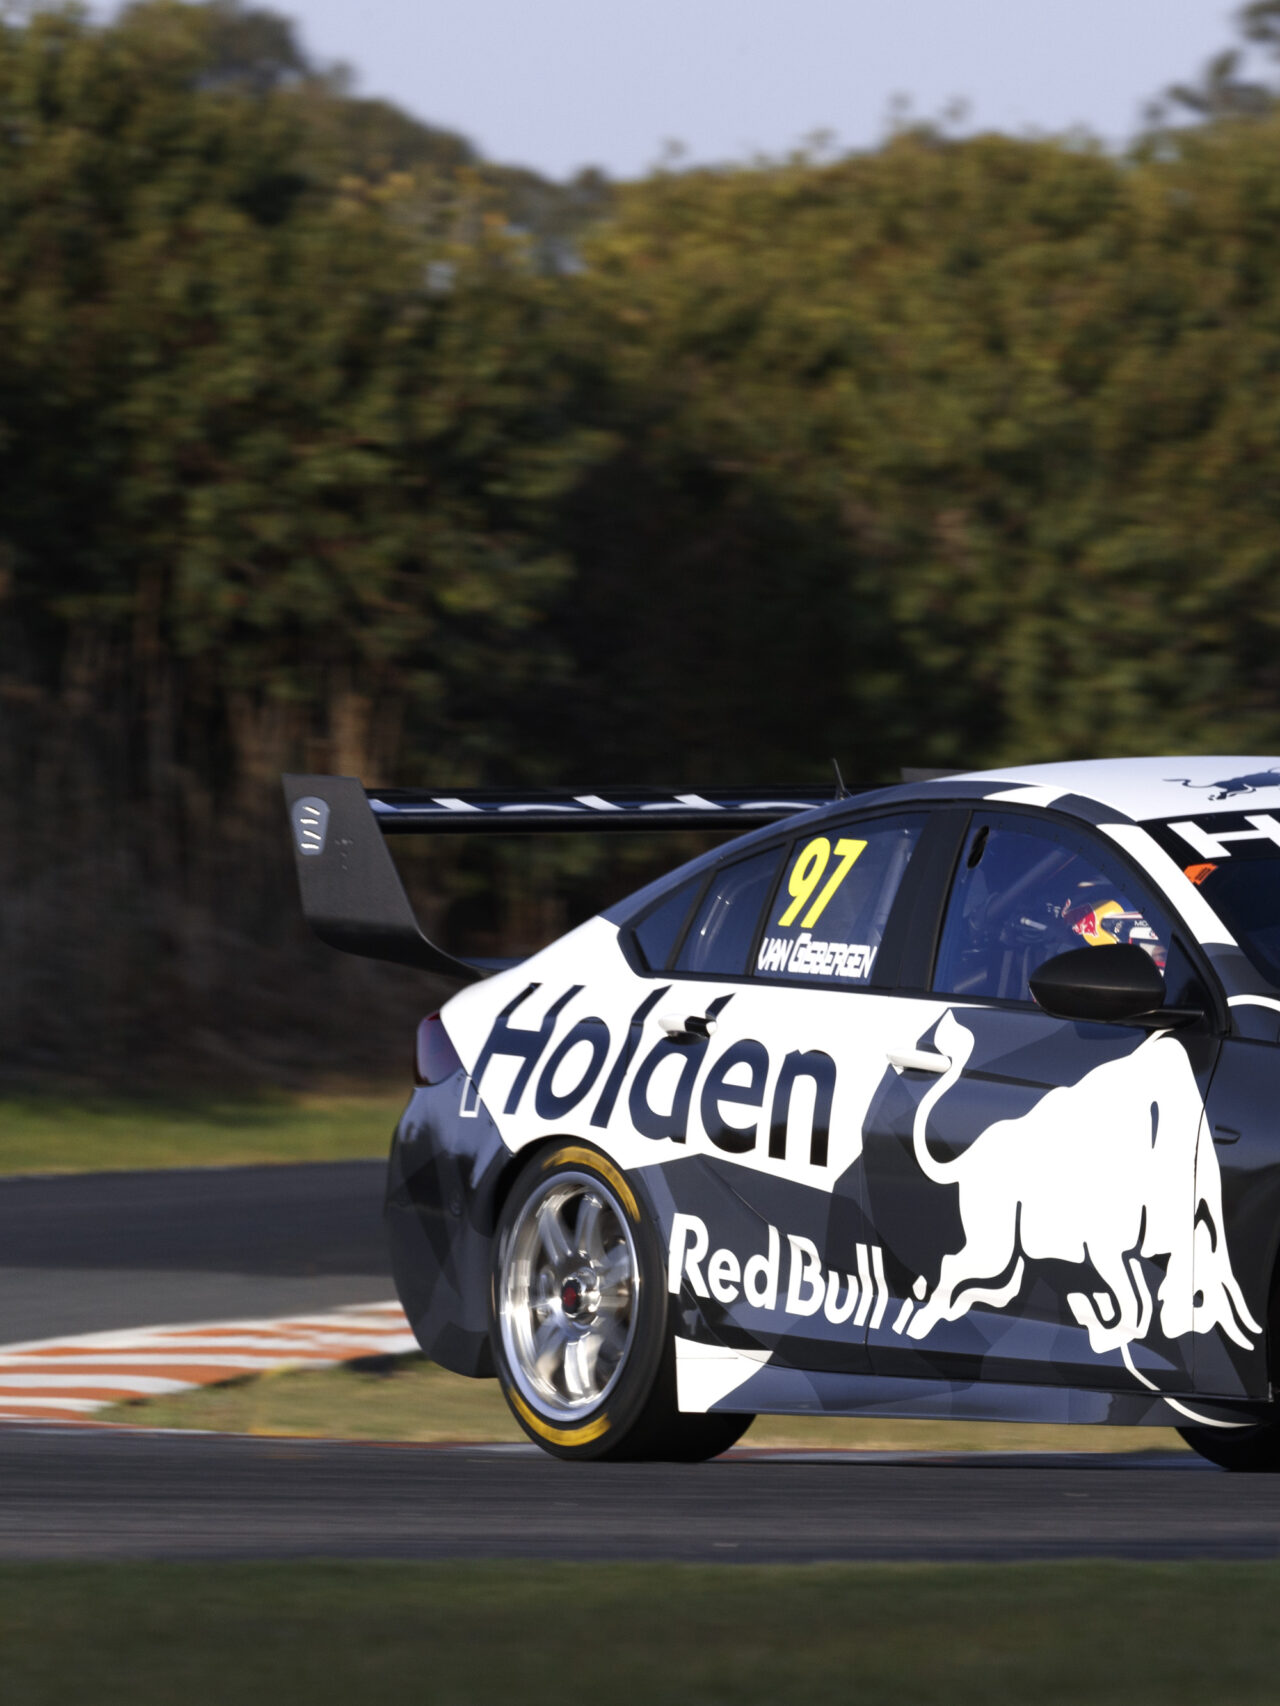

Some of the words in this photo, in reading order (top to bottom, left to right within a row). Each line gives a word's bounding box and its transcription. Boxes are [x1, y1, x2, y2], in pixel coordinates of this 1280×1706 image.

[777, 837, 868, 929] 97
[459, 982, 837, 1168] Holden
[667, 1213, 780, 1310] Red
[785, 1234, 889, 1330] Bull
